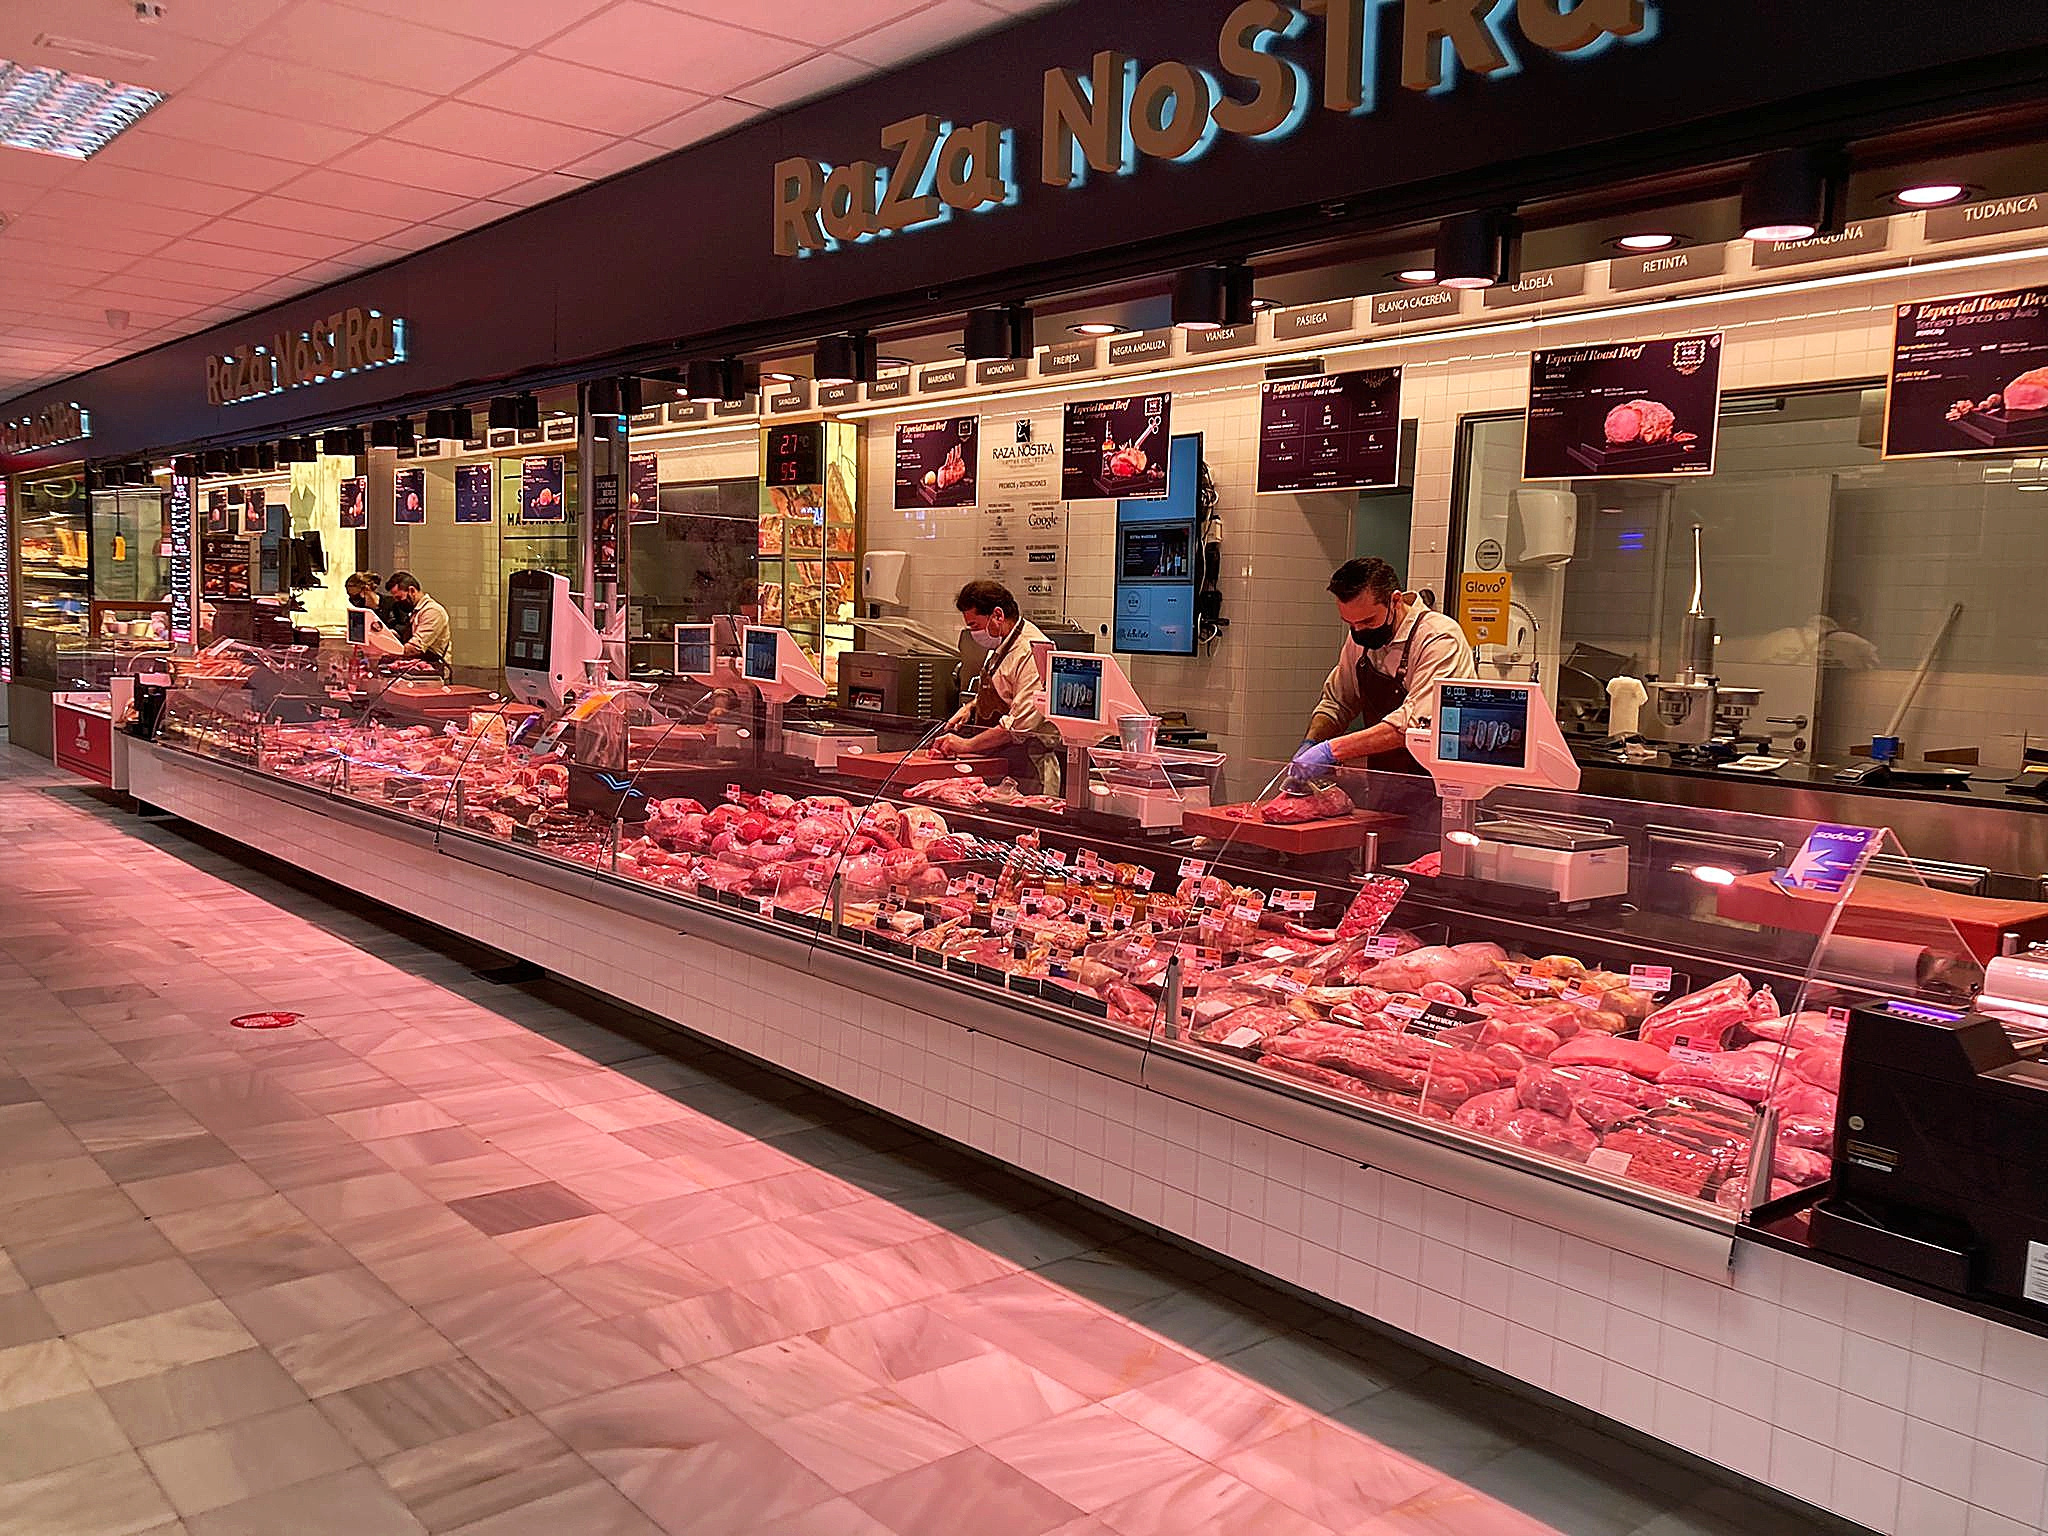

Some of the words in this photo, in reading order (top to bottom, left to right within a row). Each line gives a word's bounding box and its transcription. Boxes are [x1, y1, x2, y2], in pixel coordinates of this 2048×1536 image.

[774, 114, 1017, 257] RaZa
[1964, 197, 2038, 221] TUDANCA
[1642, 255, 1688, 273] RETINTA
[1378, 299, 1409, 313] BLANCA
[1410, 292, 1451, 309] CACEREÑA
[1916, 298, 1980, 321] Especial
[1978, 295, 2022, 312] Roast
[1296, 312, 1328, 327] PASIEGA
[1205, 329, 1235, 341] VIANESA
[1112, 346, 1133, 356] NEGRA
[1133, 340, 1166, 353] ANDALUZA
[1546, 349, 1588, 367] Especial
[1588, 347, 1618, 361] Roast
[1618, 343, 1646, 362] Beef
[1273, 381, 1301, 394] Especial
[1320, 377, 1338, 387] Beef
[781, 434, 797, 454] 27
[993, 447, 1016, 459] RAZA
[1017, 443, 1054, 458] NOSTRA
[1028, 511, 1059, 530] Google
[1466, 581, 1500, 593] Glovo
[1813, 831, 1865, 843] sodexo
